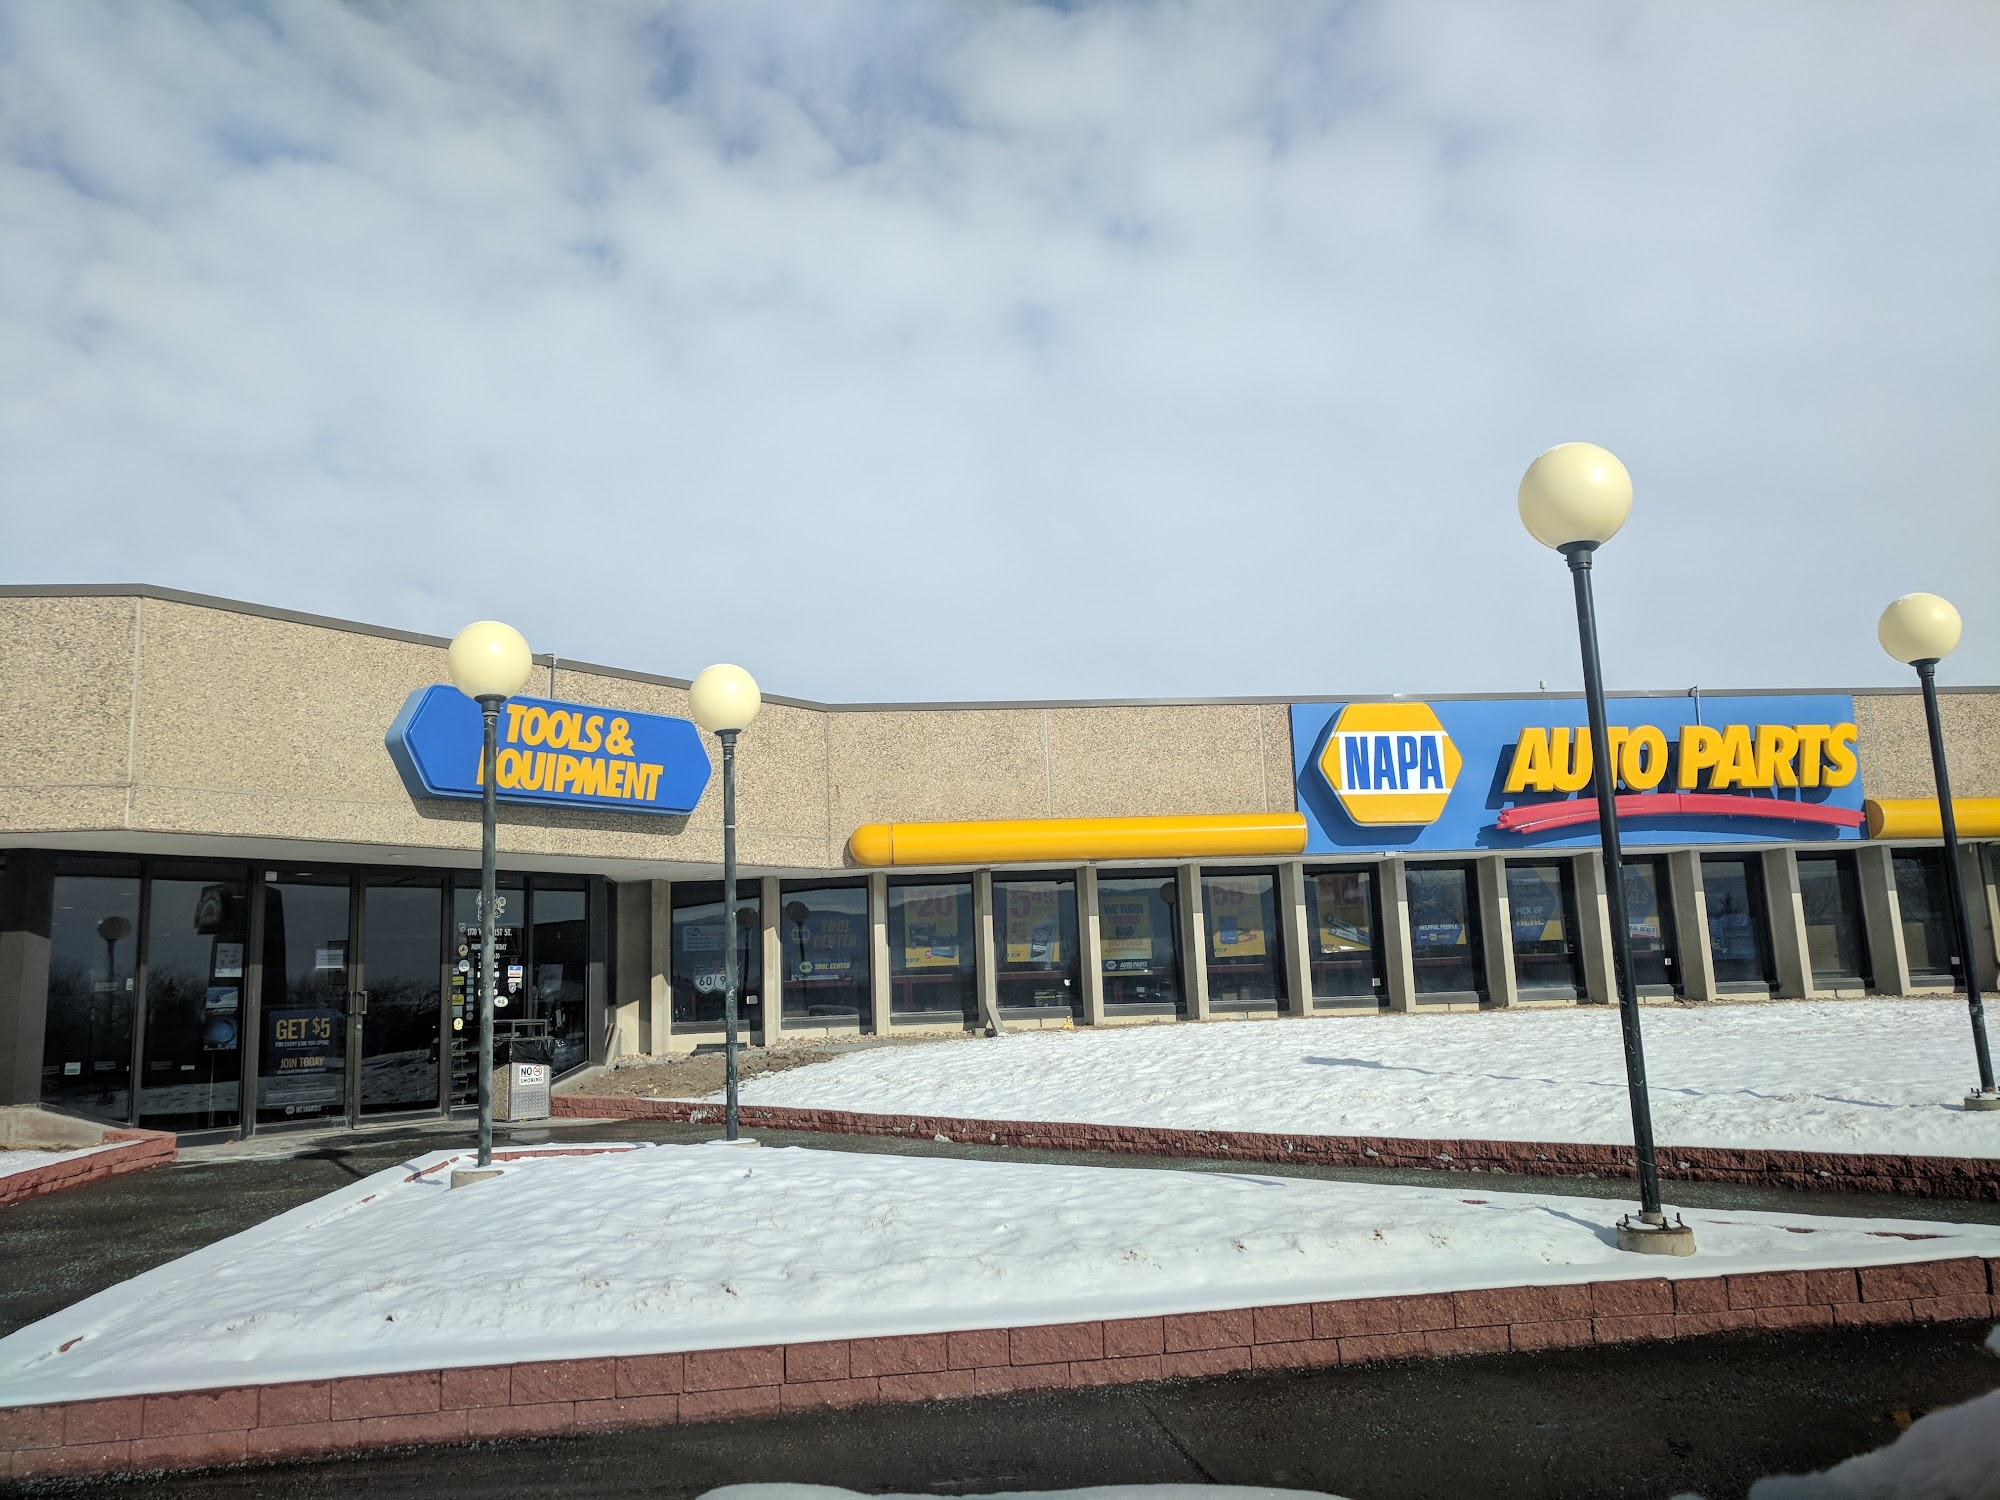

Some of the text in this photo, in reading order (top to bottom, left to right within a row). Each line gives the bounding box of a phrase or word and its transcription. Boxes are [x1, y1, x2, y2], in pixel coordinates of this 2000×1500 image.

[506, 703, 635, 757] TOOLS &
[1345, 735, 1444, 790] NAPA
[1678, 722, 1858, 790] PARTS
[1511, 878, 1540, 886] RESERVE
[1515, 906, 1543, 915] PICK UP
[820, 920, 850, 933] TOOL
[813, 933, 857, 948] CENTER
[699, 976, 712, 986] 60
[275, 1016, 331, 1040] GET $5
[280, 1056, 325, 1069] JOIN TODAY
[521, 1066, 533, 1076] NO
[521, 1076, 543, 1084] SMOKING
